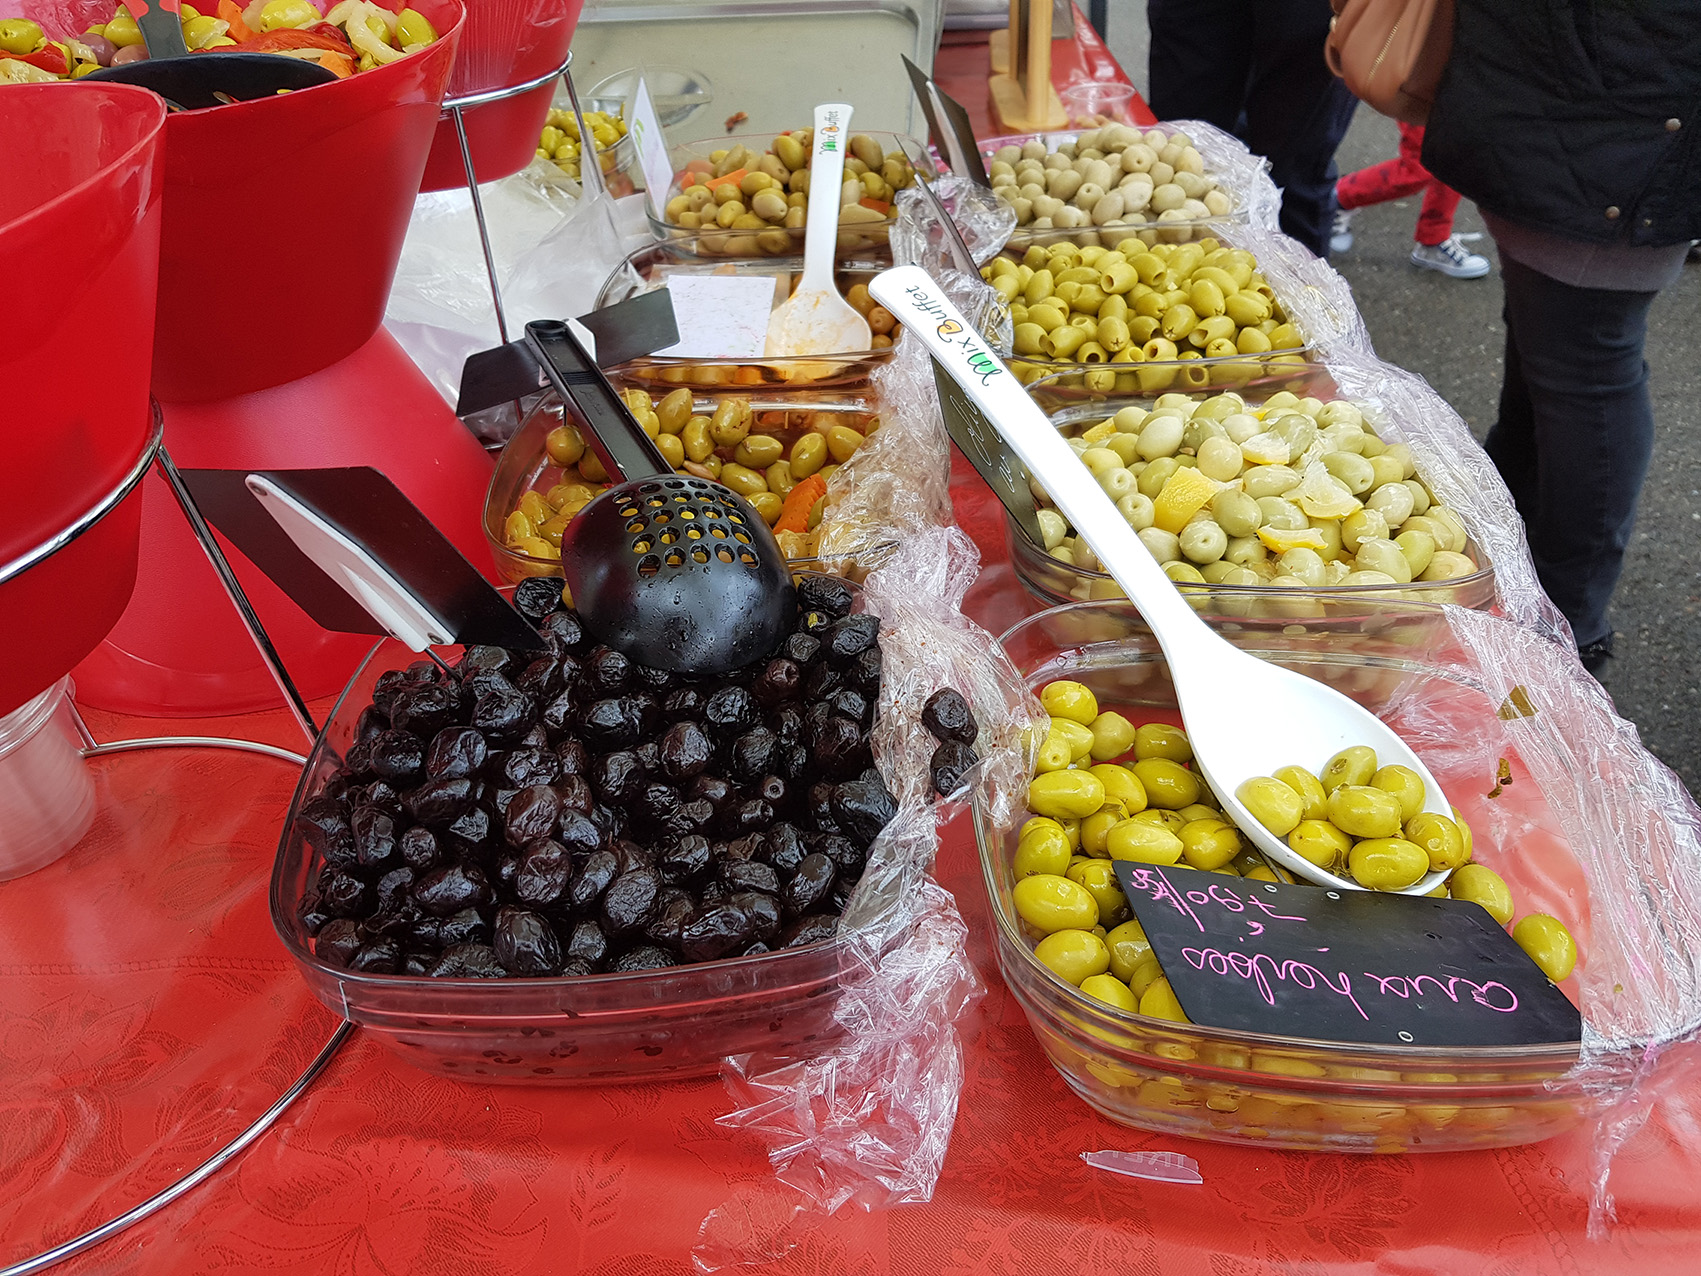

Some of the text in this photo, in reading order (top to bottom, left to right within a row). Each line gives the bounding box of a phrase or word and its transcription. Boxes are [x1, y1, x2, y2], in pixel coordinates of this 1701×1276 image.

[819, 111, 840, 155] Mix Buffet
[905, 285, 964, 343] Buffet
[958, 336, 1003, 387] Mix
[1181, 946, 1519, 1021] aux herbes
